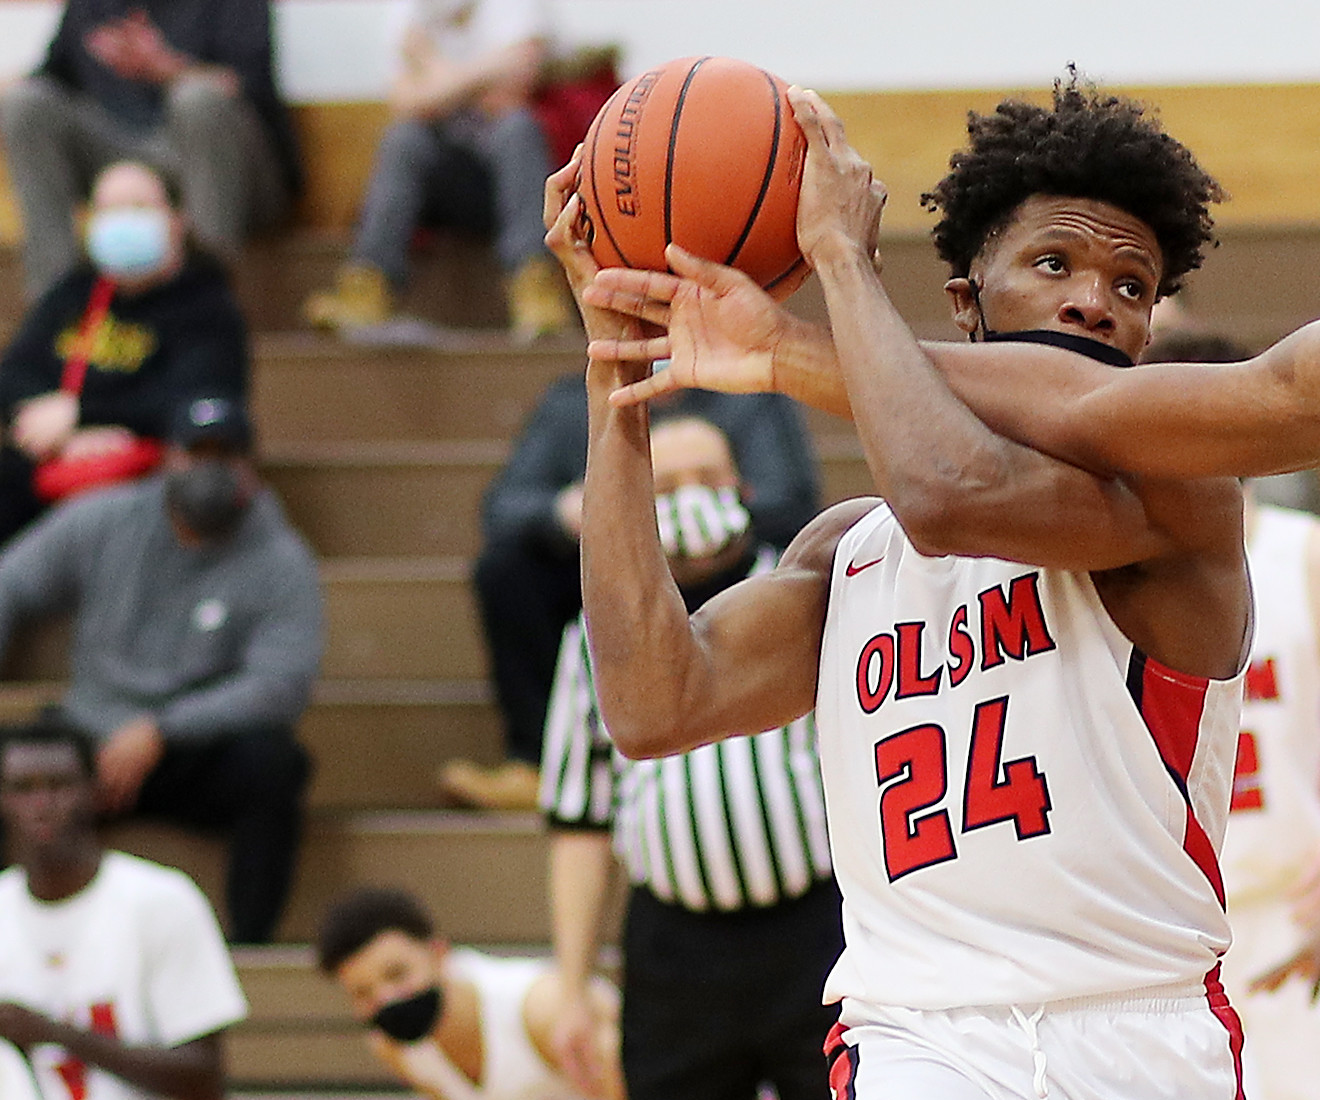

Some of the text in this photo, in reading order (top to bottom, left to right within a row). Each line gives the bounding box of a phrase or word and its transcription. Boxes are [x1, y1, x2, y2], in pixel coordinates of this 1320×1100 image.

[614, 71, 662, 217] EVOLUTION
[856, 572, 1057, 715] OLSM
[874, 695, 1053, 884] 24
